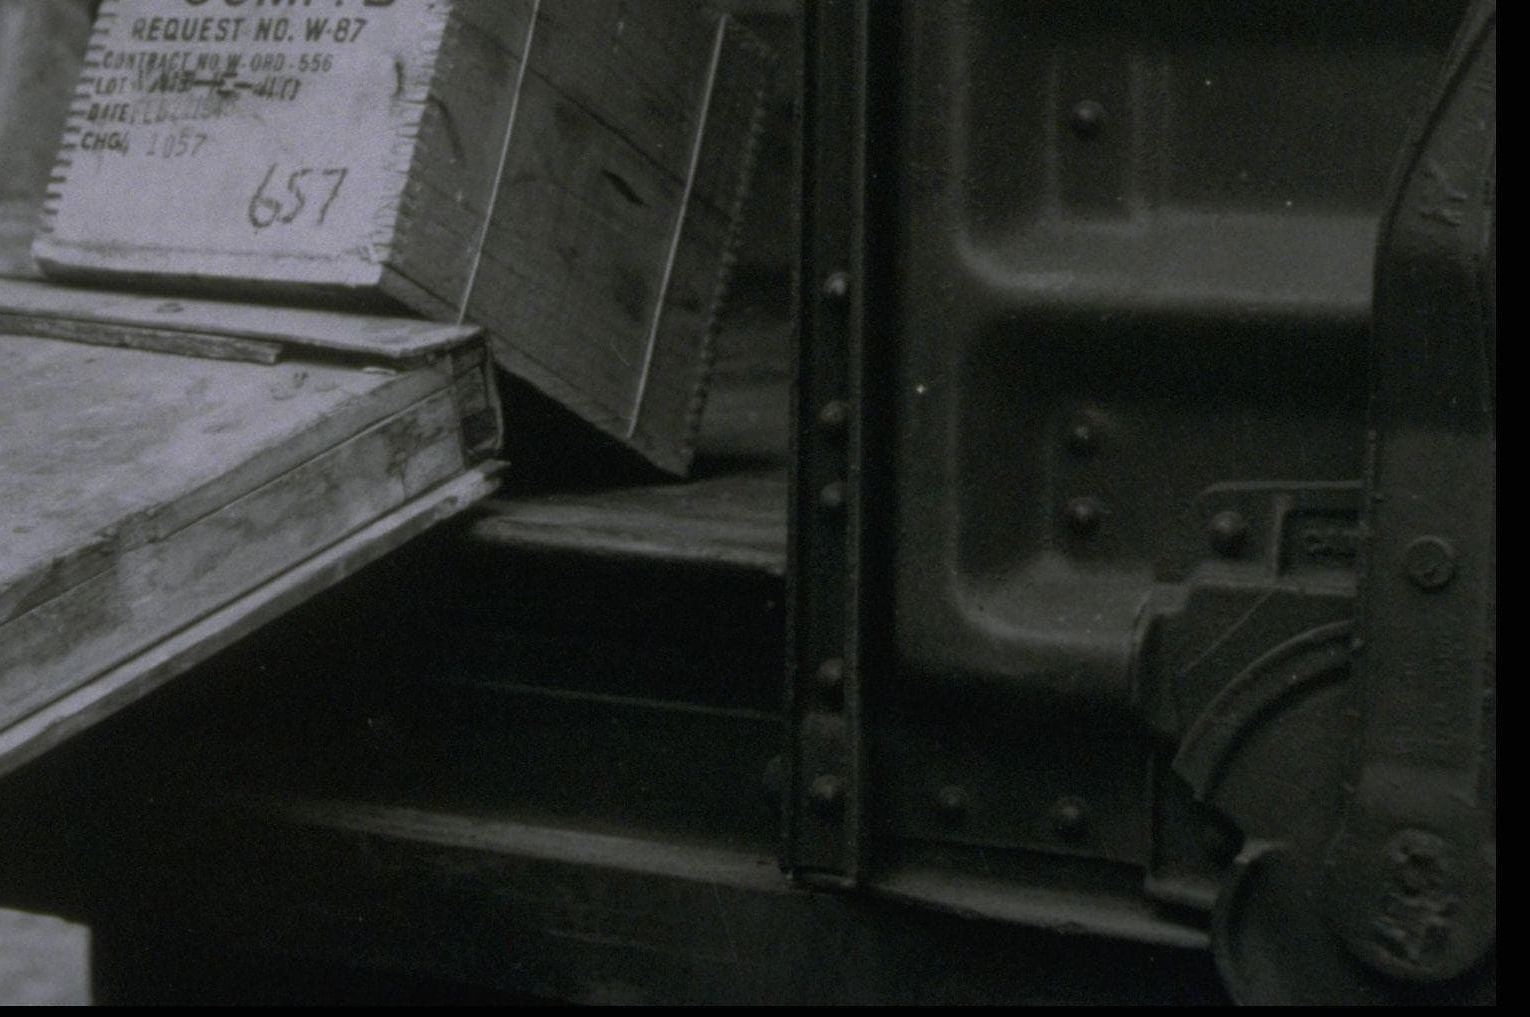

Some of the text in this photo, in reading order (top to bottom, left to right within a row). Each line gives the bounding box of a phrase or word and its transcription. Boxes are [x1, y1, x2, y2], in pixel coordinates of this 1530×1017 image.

[131, 16, 368, 44] REQUEST NO. W-87
[248, 162, 349, 230] 657
